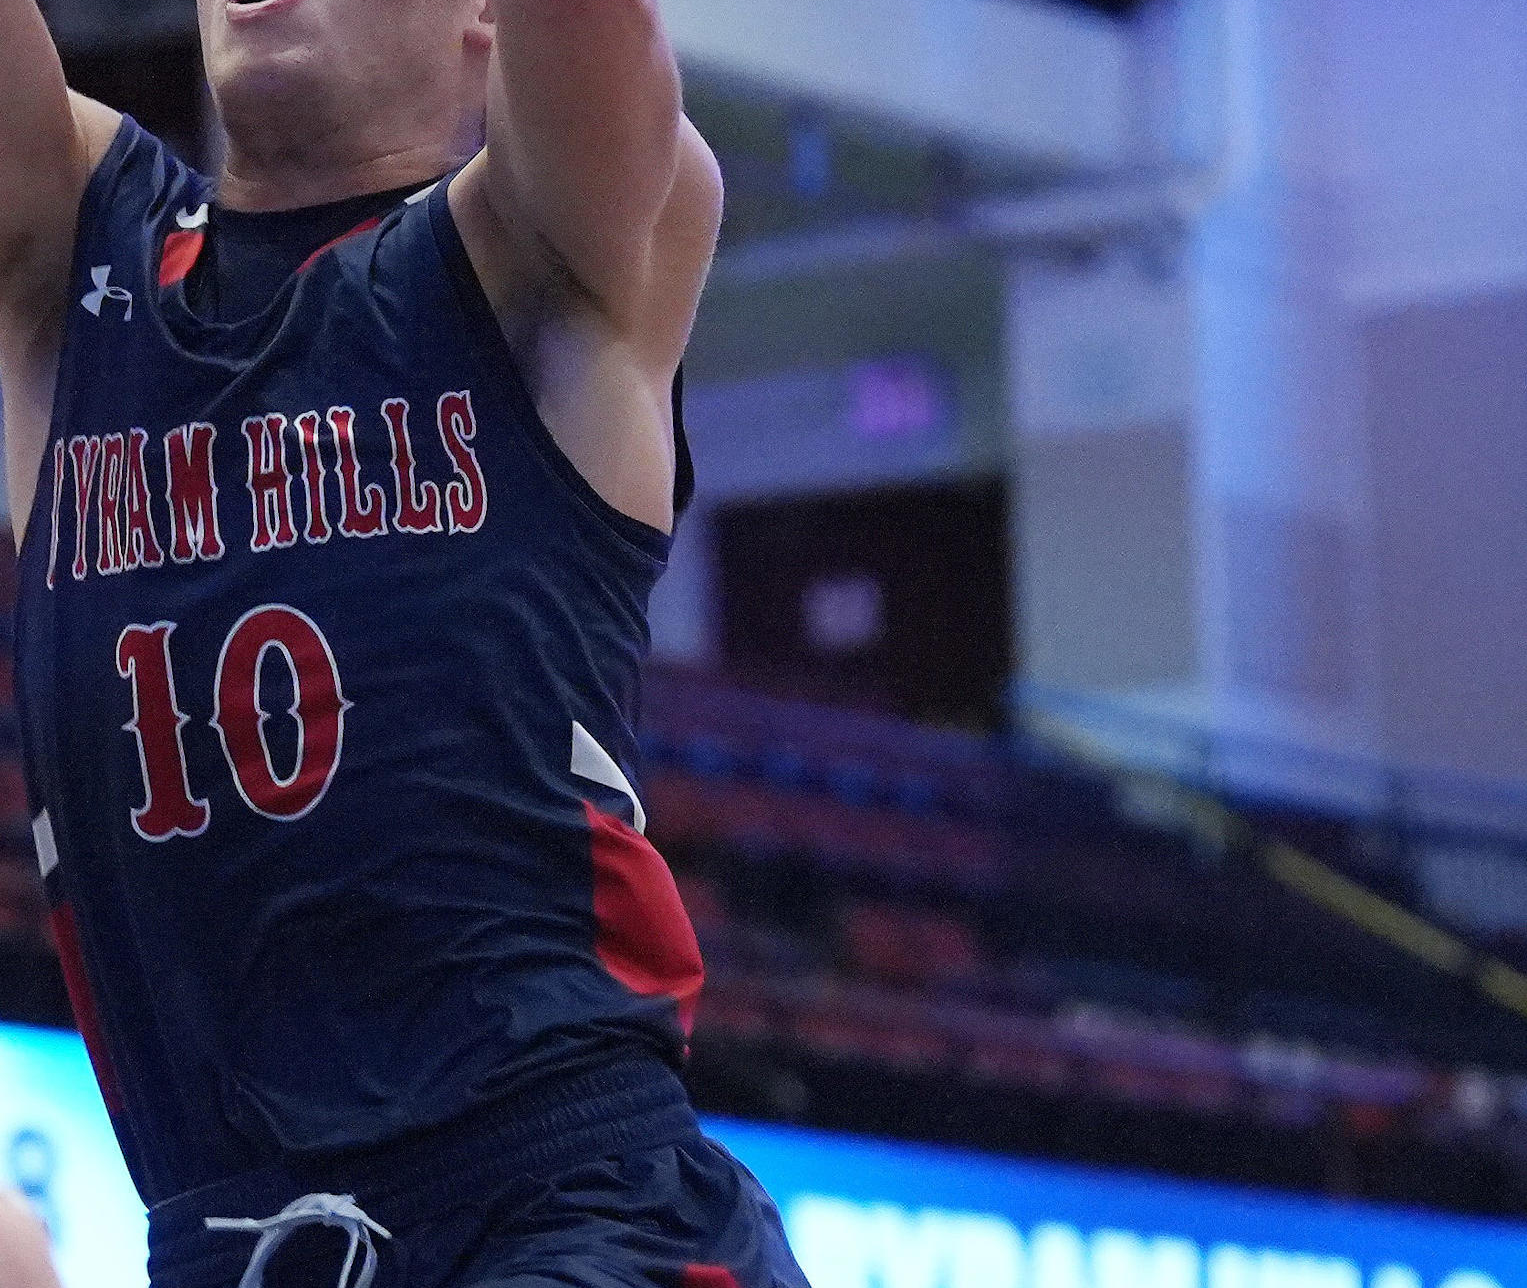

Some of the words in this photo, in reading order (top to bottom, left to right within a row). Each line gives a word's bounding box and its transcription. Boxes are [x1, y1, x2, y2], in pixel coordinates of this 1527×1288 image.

[46, 423, 227, 590] YRAM
[241, 390, 488, 552] HILLS
[116, 603, 355, 844] 10
